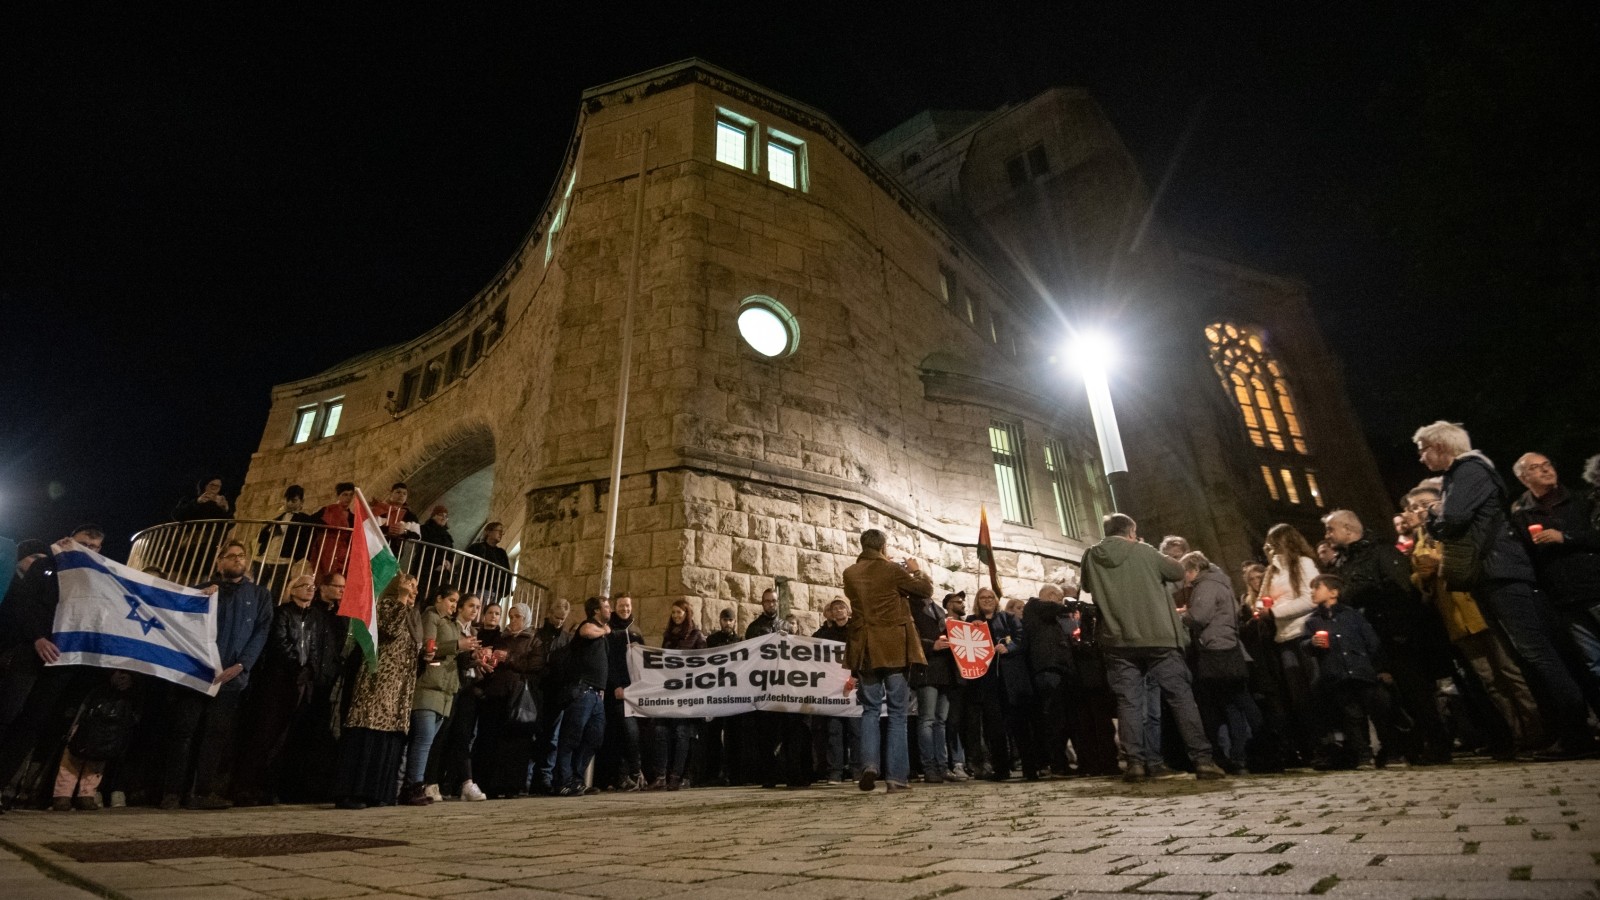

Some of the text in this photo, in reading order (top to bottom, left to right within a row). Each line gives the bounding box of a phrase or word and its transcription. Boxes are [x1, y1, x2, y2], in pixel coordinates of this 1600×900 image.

[643, 640, 846, 669] Essen stellt
[749, 669, 826, 691] quer
[638, 697, 674, 707] Bündnis
[677, 697, 704, 707] gegen
[706, 695, 751, 704] Rassismus
